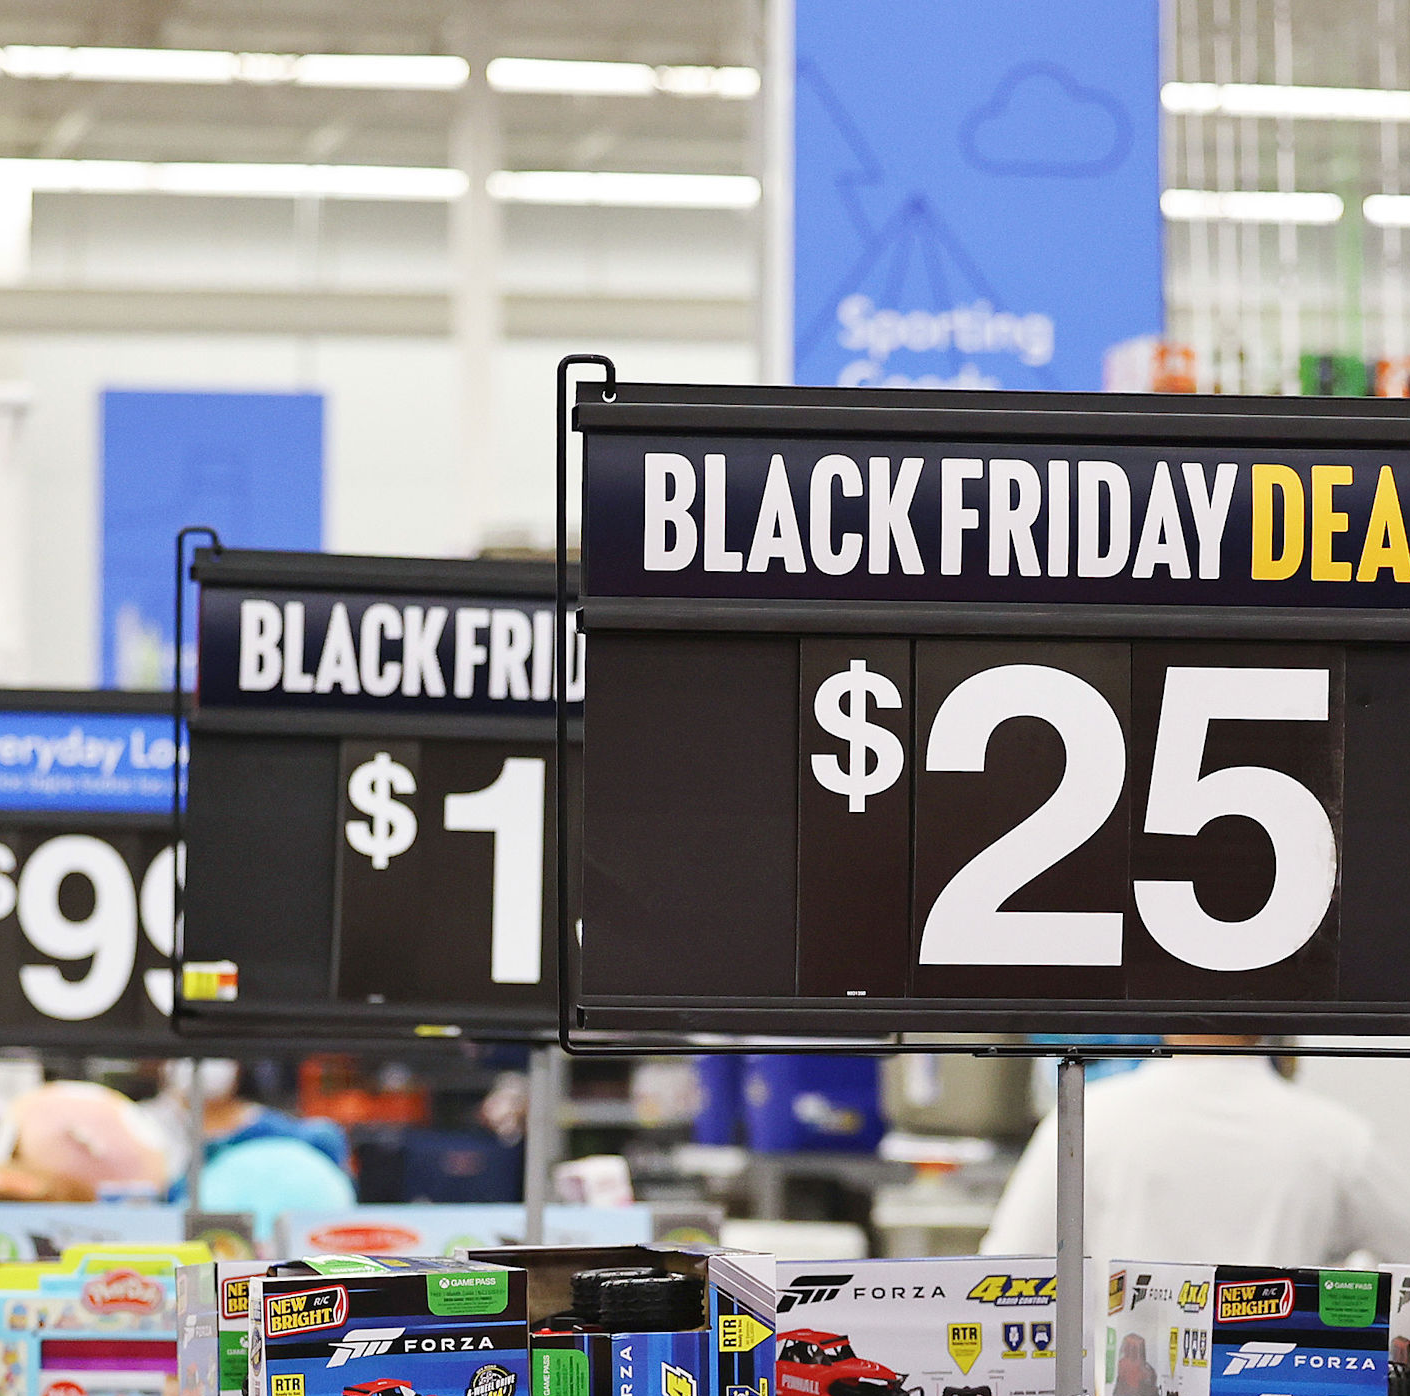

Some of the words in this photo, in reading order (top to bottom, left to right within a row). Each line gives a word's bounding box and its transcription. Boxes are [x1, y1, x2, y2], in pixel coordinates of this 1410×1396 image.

[643, 452, 925, 577] BLACK
[941, 457, 1240, 581] FRIDAY
[240, 600, 451, 698] BLACK
[810, 659, 1339, 972] $25
[451, 1278, 475, 1287] GAME
[476, 1277, 496, 1286] PASS
[1334, 1281, 1354, 1290] GAME
[1355, 1282, 1373, 1291] PASS
[854, 1286, 946, 1300] FORZA
[1221, 1286, 1257, 1303] NEW
[1262, 1287, 1278, 1297] R/C
[271, 1295, 308, 1317] NEW
[313, 1296, 330, 1307] R/C
[1222, 1299, 1281, 1318] BRIGHT
[271, 1307, 333, 1332] BRIGHT
[723, 1319, 738, 1348] RTR
[952, 1326, 978, 1341] RTR
[404, 1336, 494, 1353] FORZA
[1294, 1355, 1376, 1371] FORZA
[276, 1378, 301, 1392] RTR
